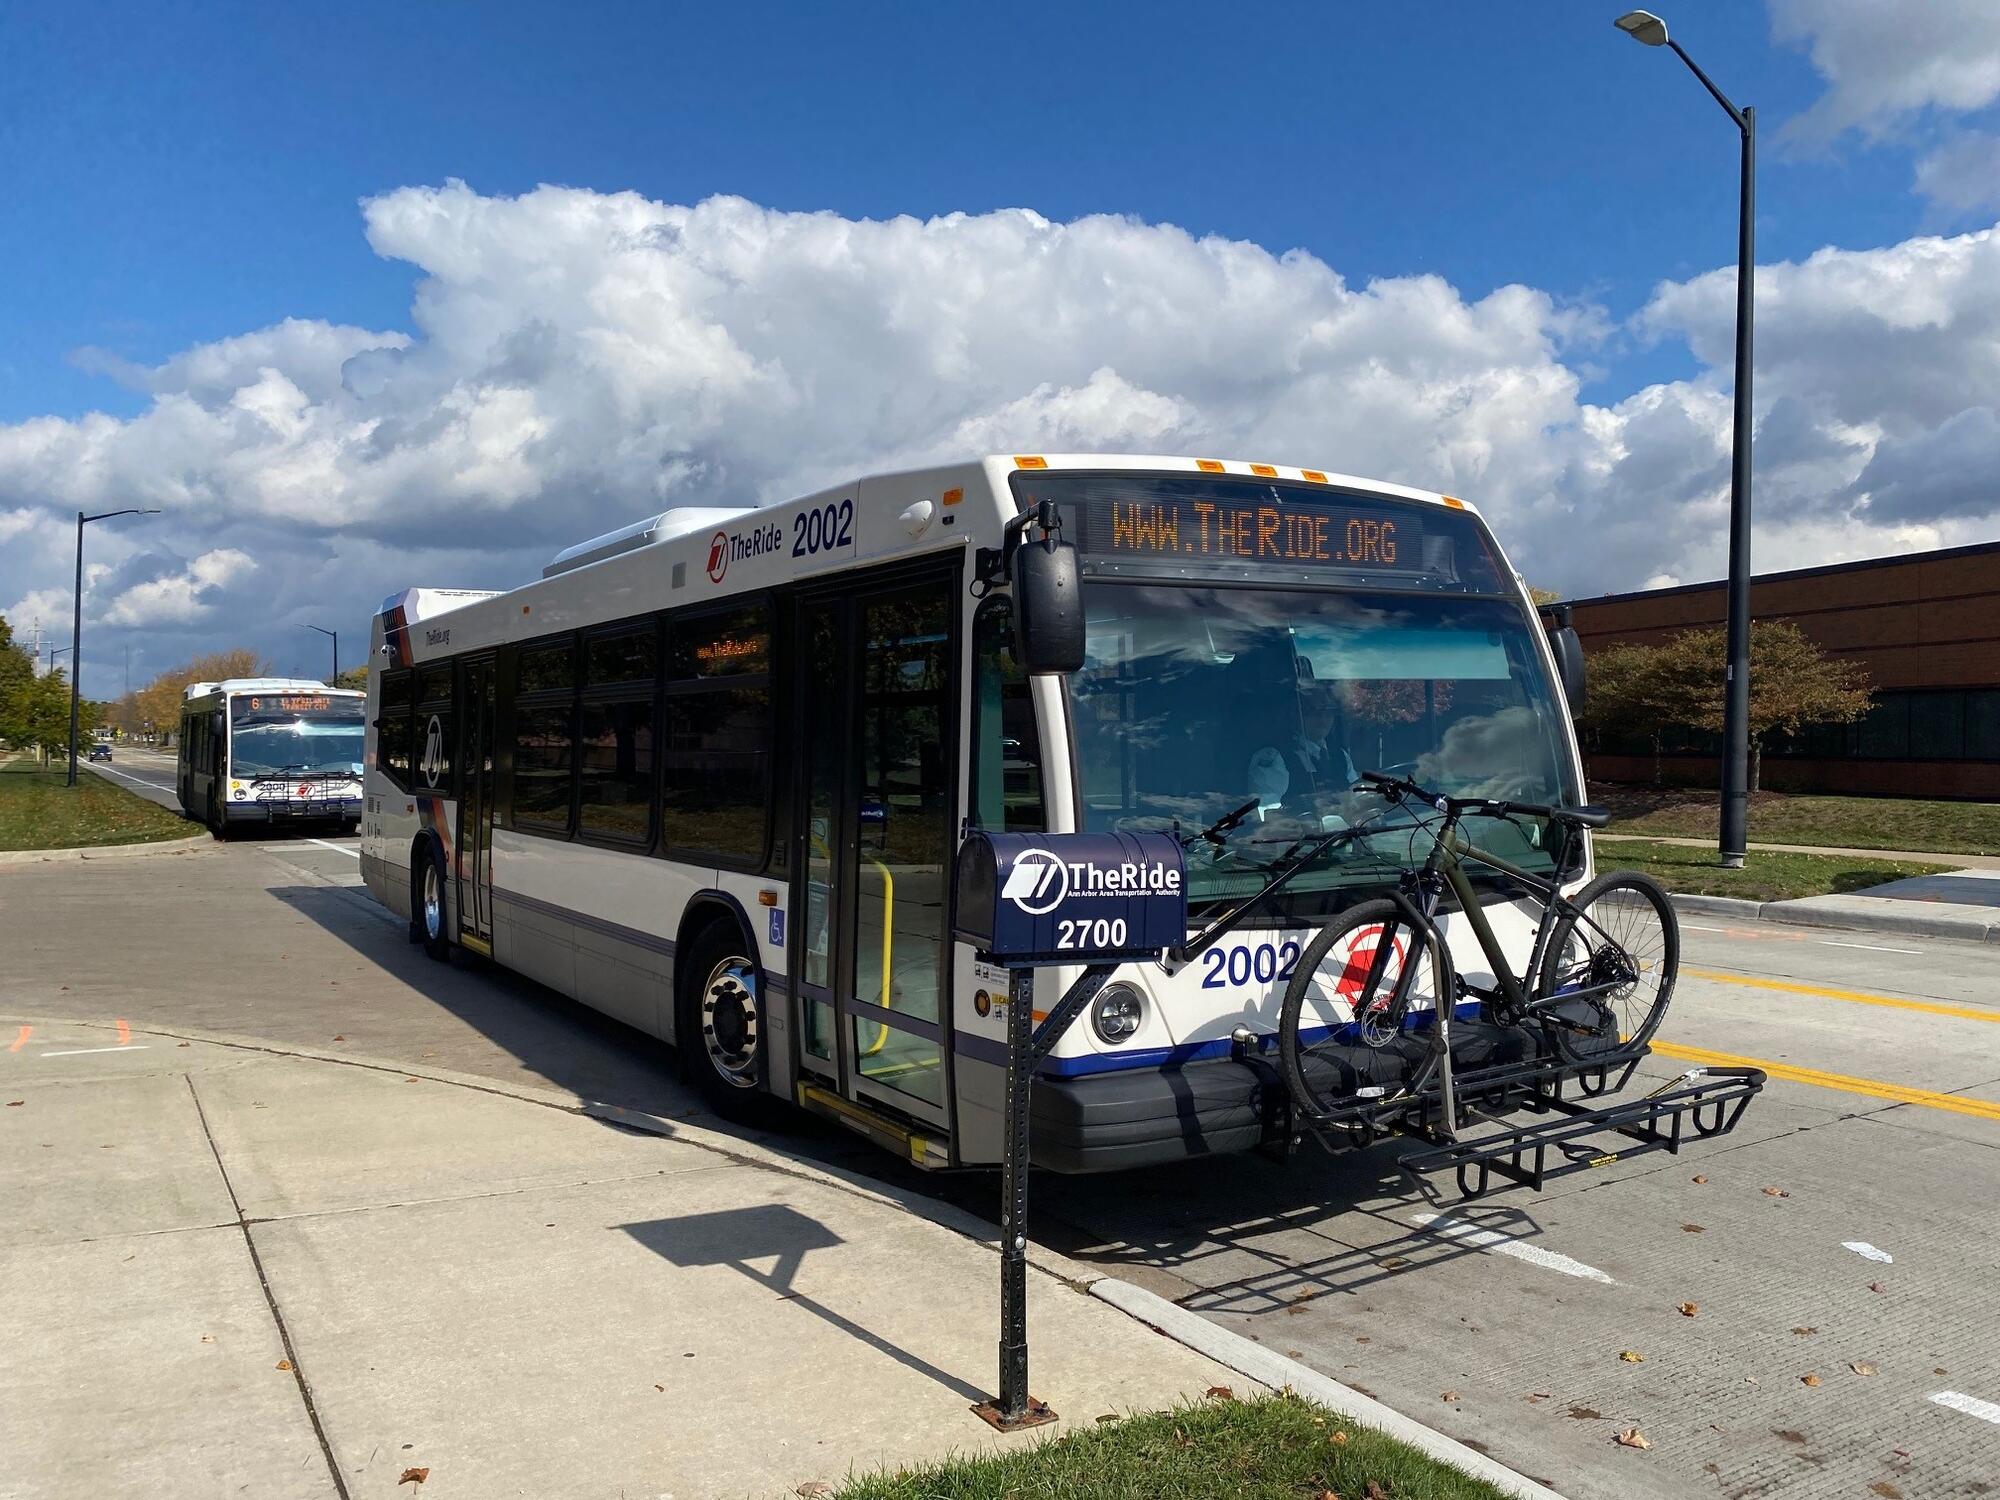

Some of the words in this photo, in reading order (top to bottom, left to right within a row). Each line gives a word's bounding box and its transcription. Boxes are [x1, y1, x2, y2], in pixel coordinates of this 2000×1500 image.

[729, 523, 782, 562] TheRide
[792, 498, 854, 558] 2002
[251, 697, 260, 710] 6
[1067, 862, 1181, 890] TheRide
[1081, 889, 1097, 897] Arbor
[1099, 889, 1114, 897] Area
[1114, 889, 1152, 898] Transportation
[1155, 889, 1181, 897] Authority
[1057, 918, 1127, 949] 2700
[1201, 941, 1301, 989] 2002
